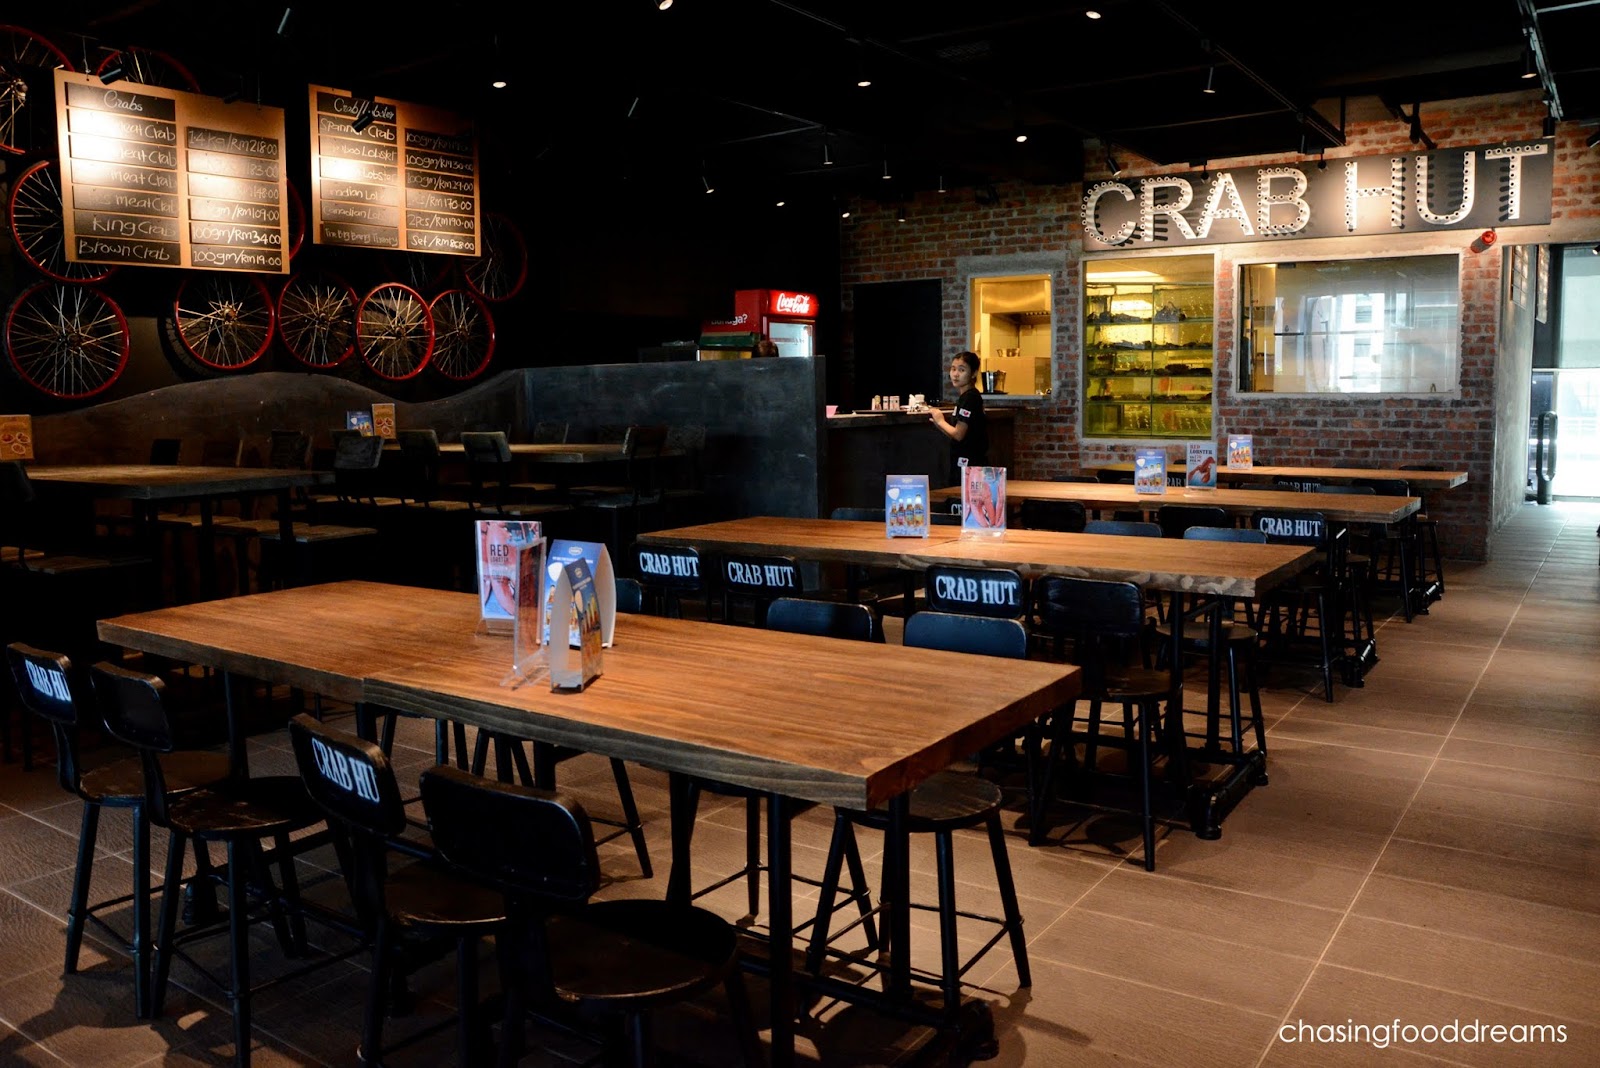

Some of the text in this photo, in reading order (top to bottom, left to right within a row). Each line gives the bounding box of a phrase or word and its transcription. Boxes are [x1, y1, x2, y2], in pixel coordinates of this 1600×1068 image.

[104, 90, 143, 112] Crabs
[144, 122, 176, 141] Crab
[368, 126, 395, 140] Crab
[148, 151, 177, 168] Crab
[1082, 144, 1548, 246] CRAB HUT
[78, 238, 170, 260] Brown Crab
[1166, 477, 1182, 487] RAB
[1260, 517, 1321, 537] CRAB HUT
[490, 544, 509, 556] RED
[639, 552, 700, 578] CRAB HUT
[728, 561, 794, 588] CRAB HUT
[936, 576, 1017, 606] CRAB HUT
[48, 668, 72, 702] HU
[311, 737, 380, 804] CRAB HU
